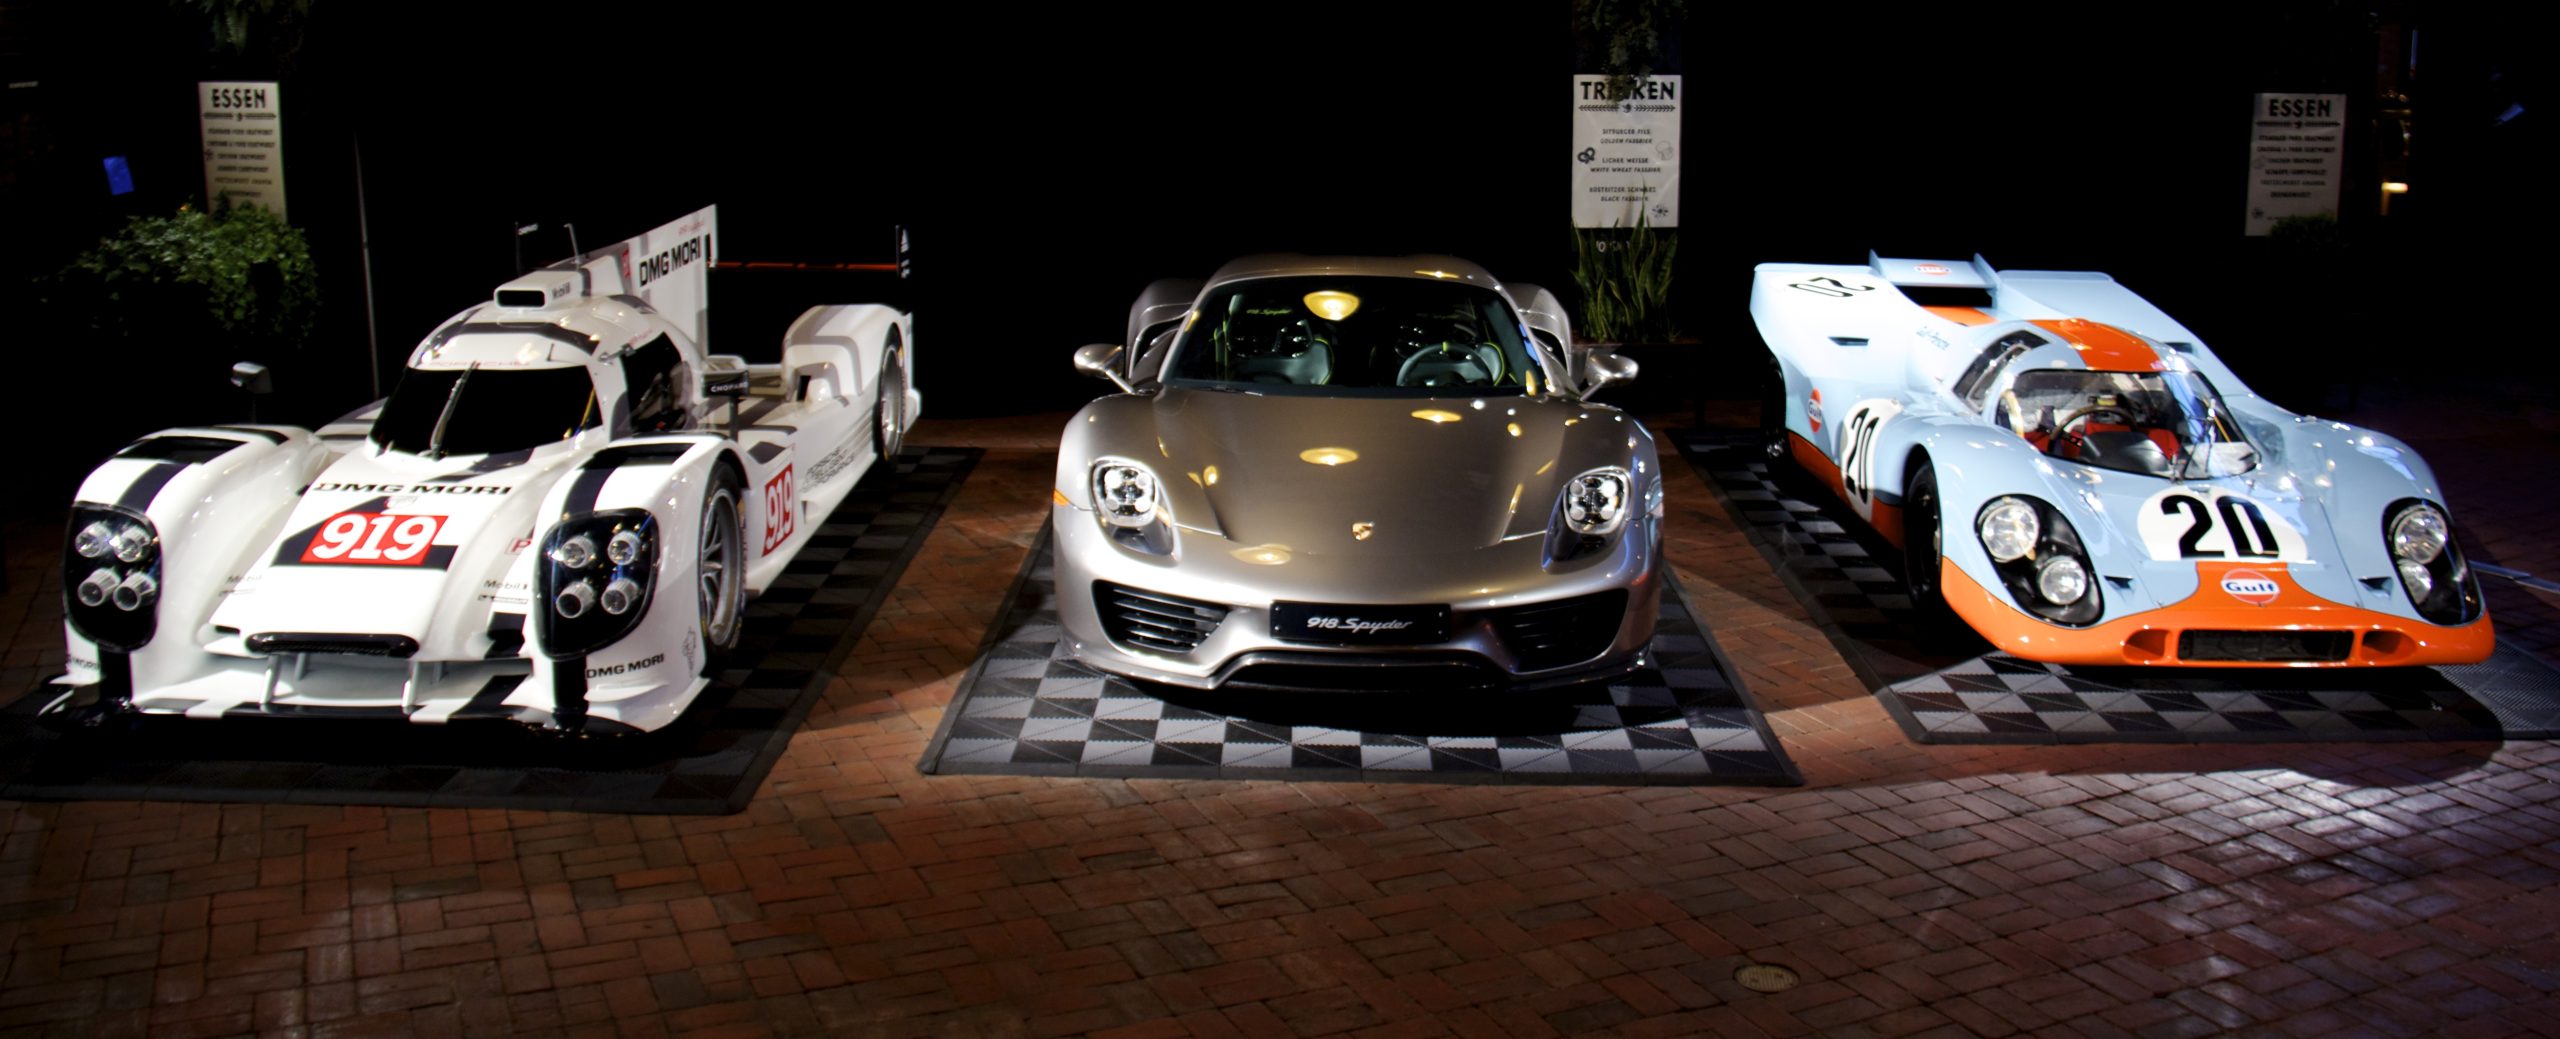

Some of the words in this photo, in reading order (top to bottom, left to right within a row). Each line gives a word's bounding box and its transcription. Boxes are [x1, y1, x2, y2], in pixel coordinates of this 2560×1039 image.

[212, 88, 266, 108] ESSEN
[1580, 81, 1675, 100] TRIKEN
[2269, 98, 2331, 117] ESSEN
[639, 251, 669, 288] DMG
[671, 235, 701, 272] MORI
[1845, 407, 1880, 504] 20
[312, 482, 405, 494] DMG
[409, 482, 513, 496] MORI
[766, 471, 792, 550] 919
[2160, 494, 2280, 558] 20
[311, 513, 438, 561] 919
[485, 579, 520, 590] Mobil
[2225, 582, 2275, 592] Gulf
[1306, 617, 1339, 629] 918
[1338, 618, 1413, 635] Spyder
[586, 664, 625, 679] DMG
[628, 653, 664, 672] MORI
